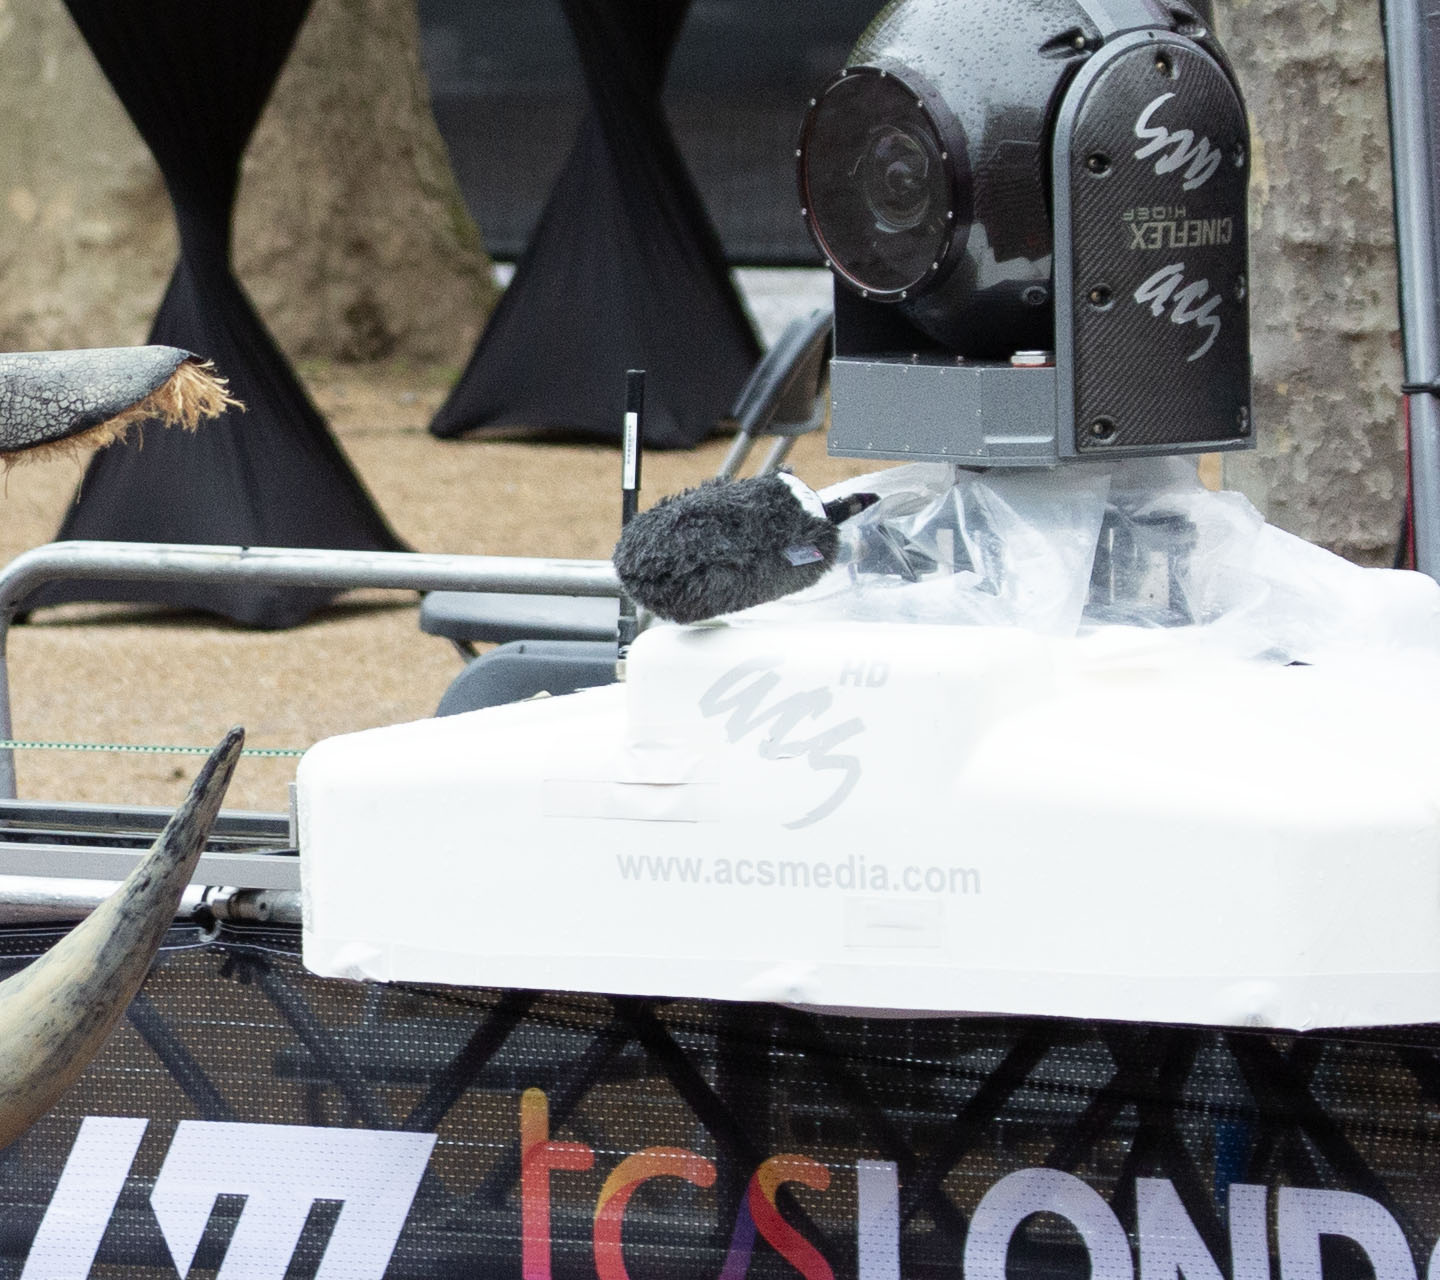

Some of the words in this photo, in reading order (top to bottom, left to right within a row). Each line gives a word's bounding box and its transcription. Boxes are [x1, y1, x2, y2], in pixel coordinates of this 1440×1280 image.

[1130, 217, 1234, 250] CINEFLEX
[838, 659, 893, 689] HD
[616, 853, 982, 895] www.acsmedia.com
